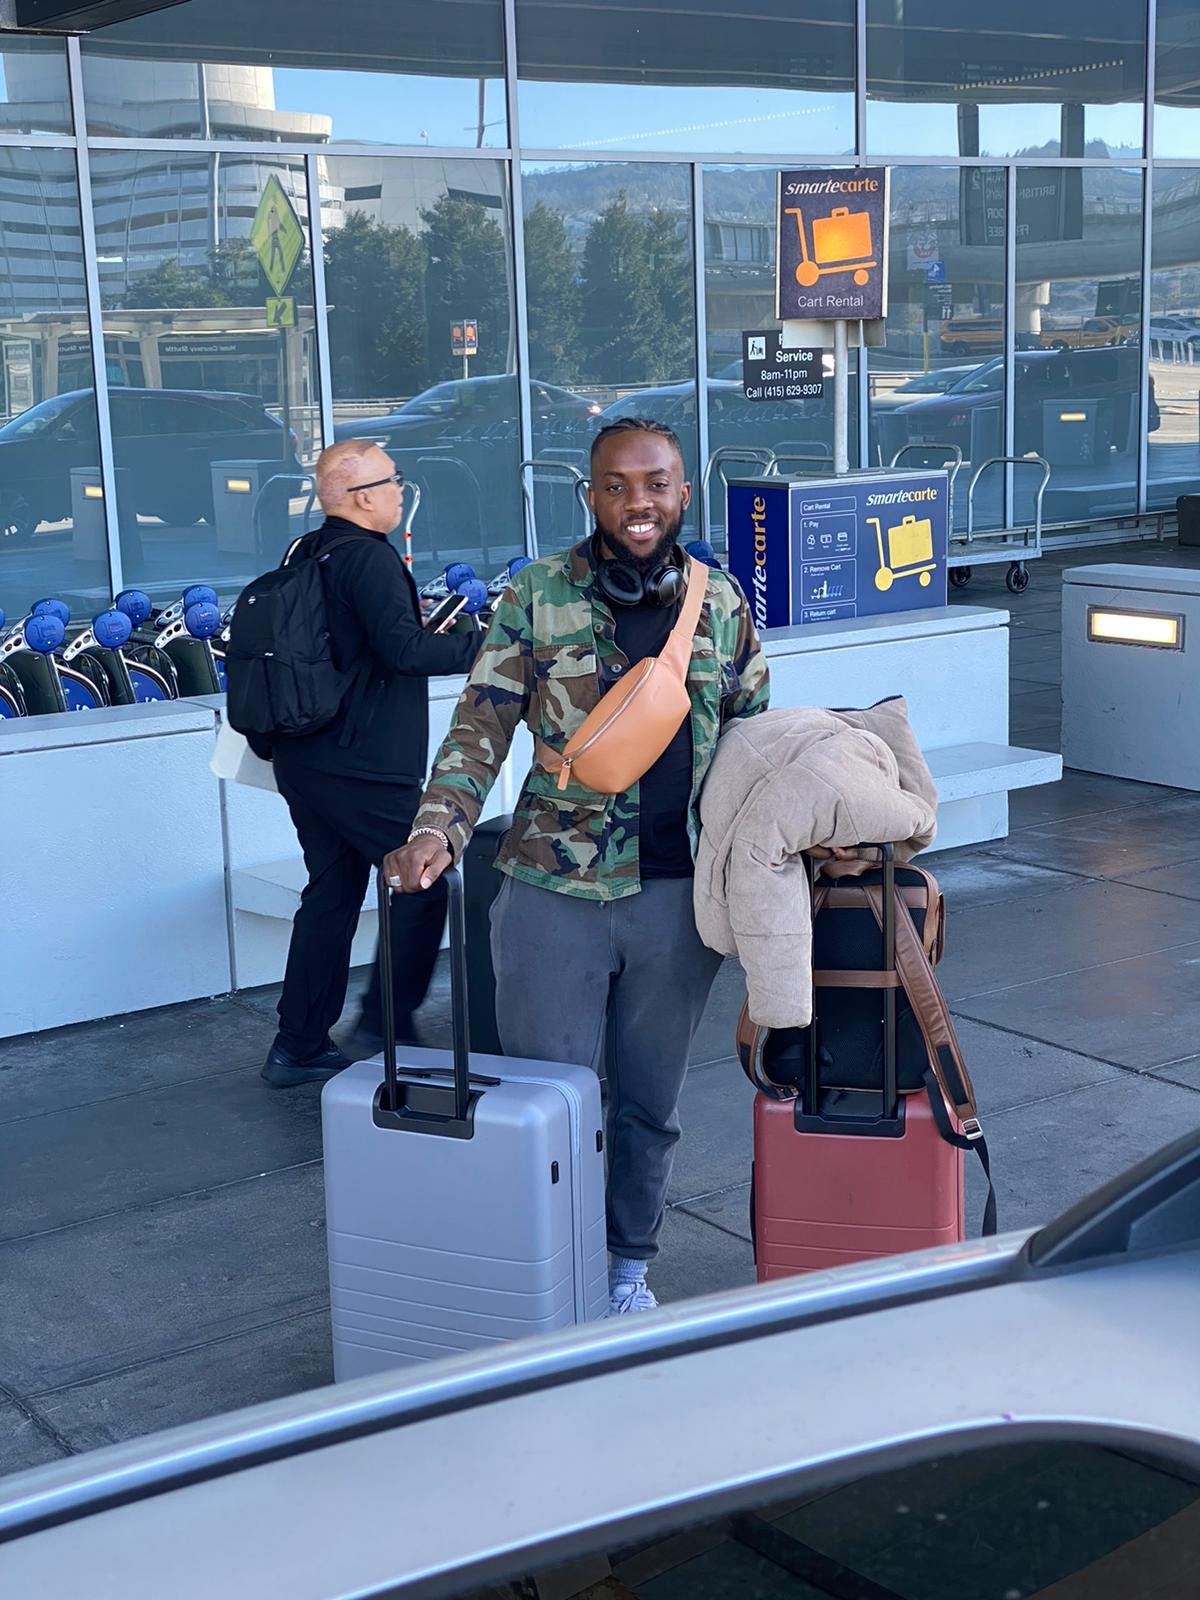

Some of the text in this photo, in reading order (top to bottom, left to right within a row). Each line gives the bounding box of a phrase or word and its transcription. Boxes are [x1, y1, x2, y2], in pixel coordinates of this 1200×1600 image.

[785, 178, 879, 195] smartecarte
[797, 295, 864, 307] Cart Rental
[775, 350, 813, 363] Service
[760, 369, 808, 381] 8am-11pm
[746, 384, 822, 399] Call (415) 629-9307
[866, 487, 937, 506] smartecarte
[751, 496, 767, 631] artecarte
[803, 566, 809, 574] 2.
